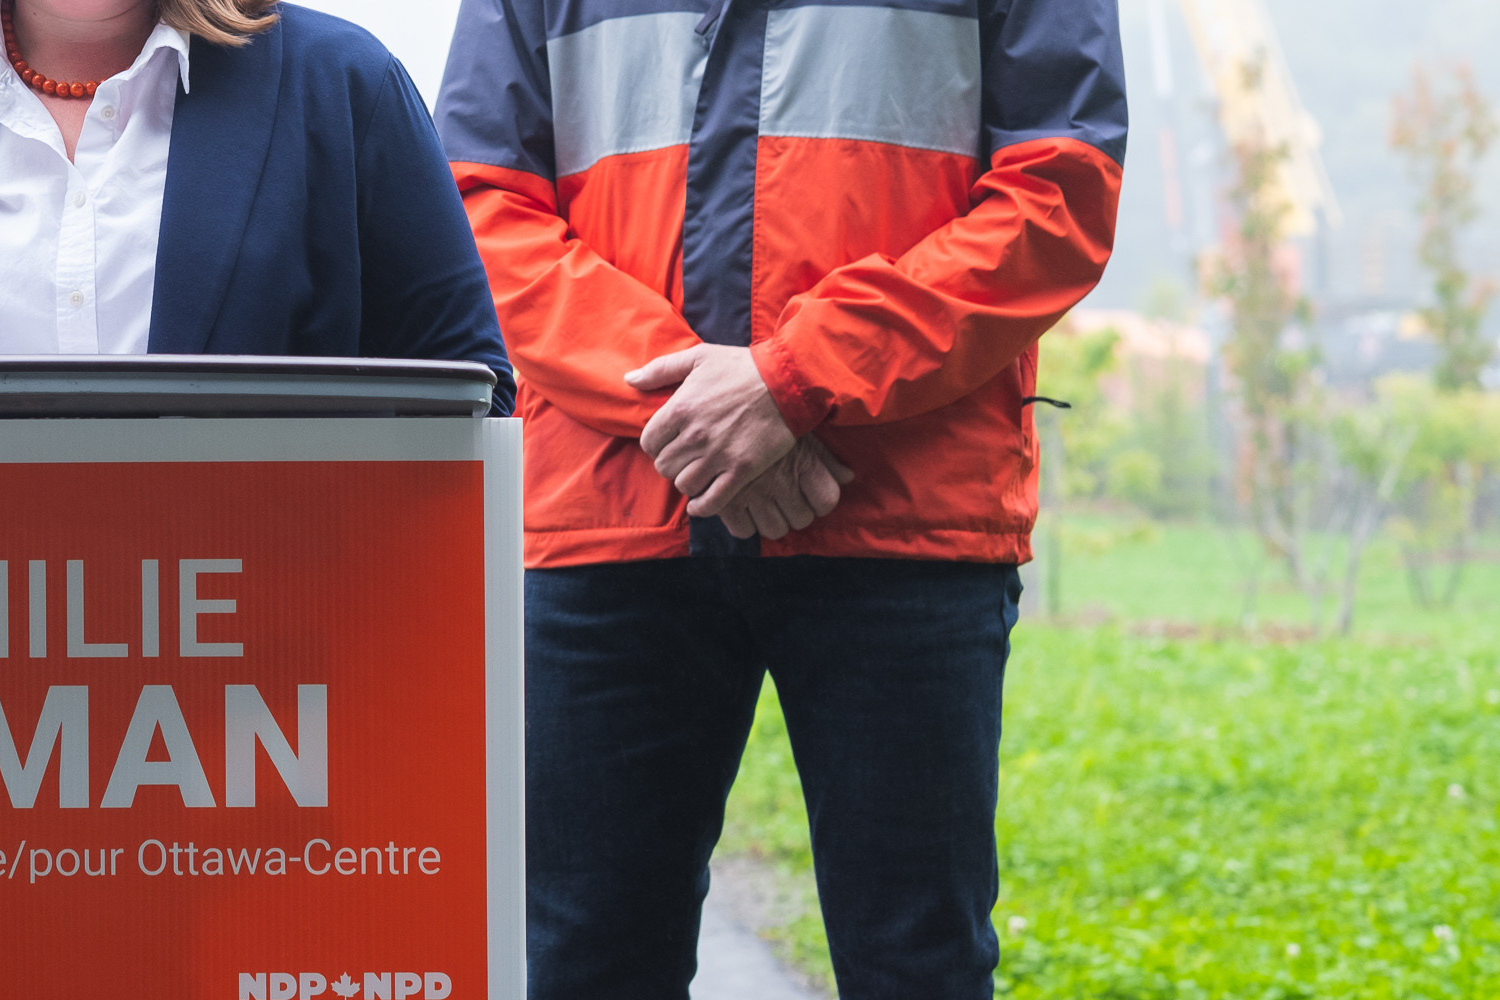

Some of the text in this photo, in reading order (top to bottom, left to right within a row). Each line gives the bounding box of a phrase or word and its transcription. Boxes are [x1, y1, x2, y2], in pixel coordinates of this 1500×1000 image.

[137, 838, 441, 877] Ottawa-Centre
[238, 971, 453, 1000] NDP NPD
